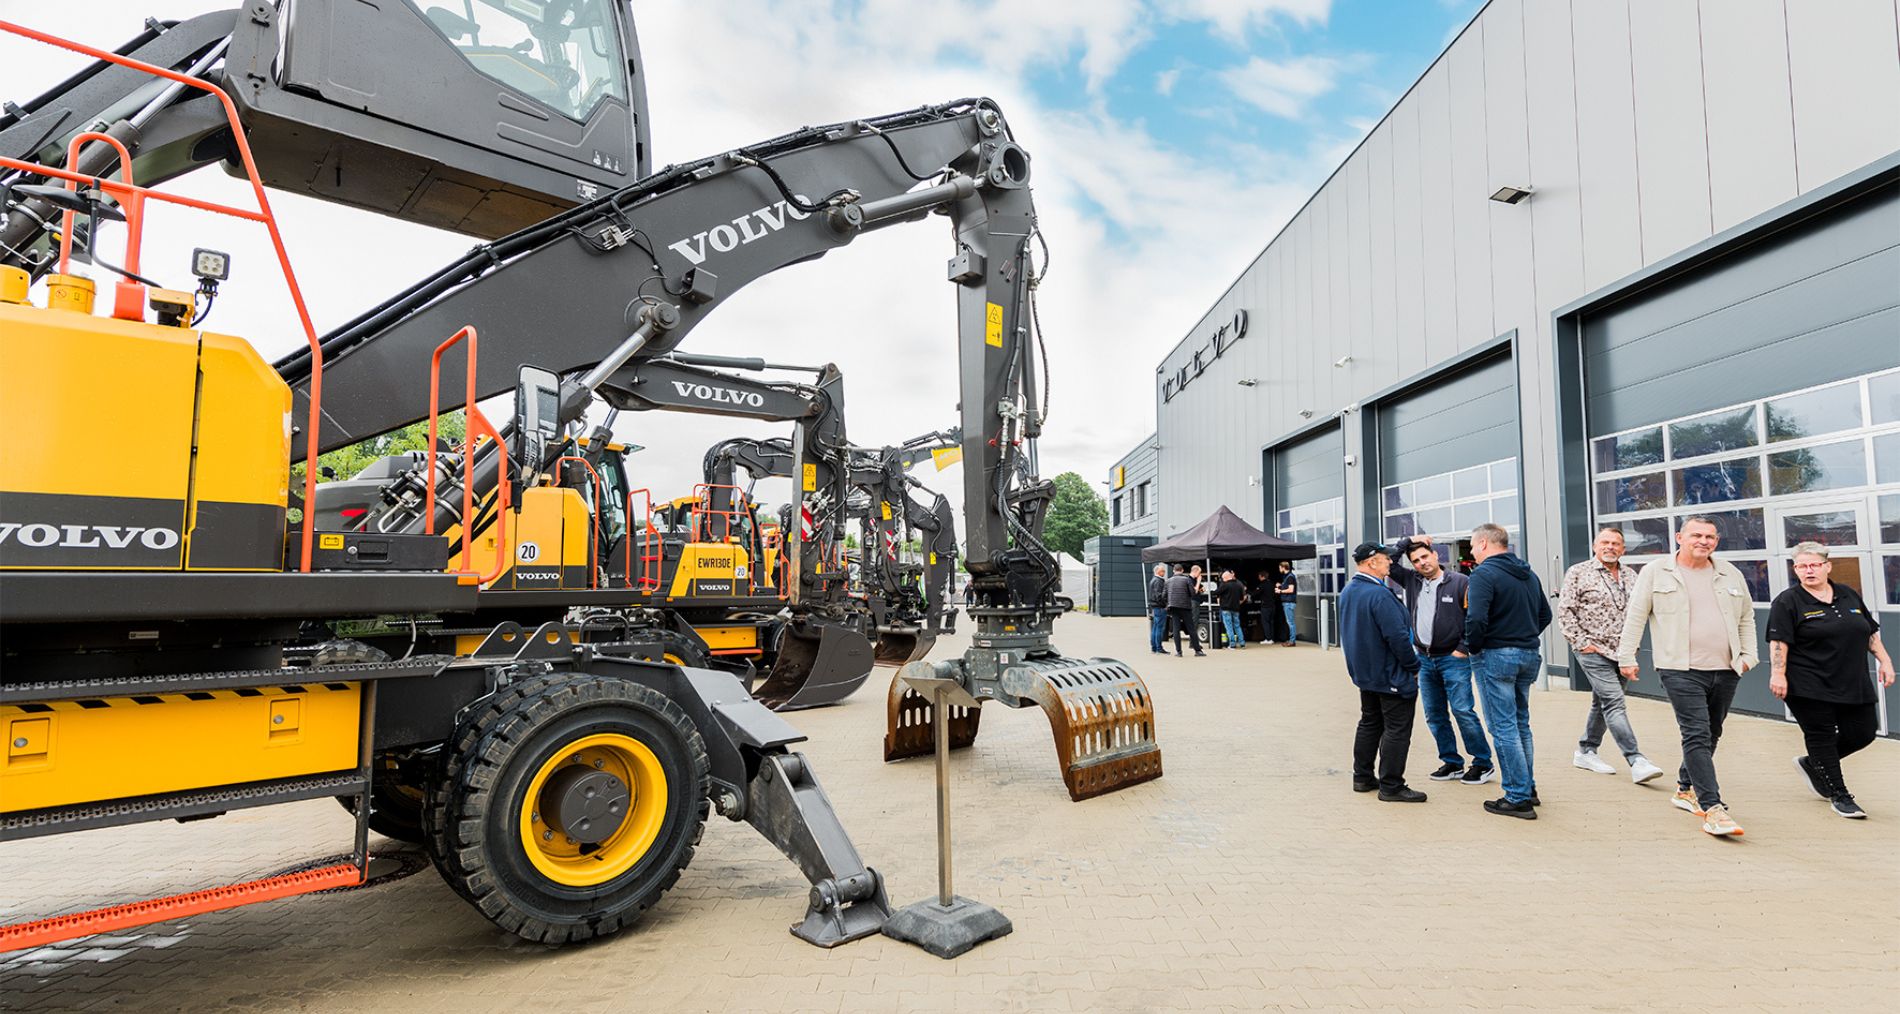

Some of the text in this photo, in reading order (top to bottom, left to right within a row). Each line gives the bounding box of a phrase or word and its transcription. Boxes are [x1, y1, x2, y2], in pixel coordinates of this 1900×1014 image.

[668, 194, 813, 265] VOLVO
[671, 381, 764, 407] VOLVO
[521, 545, 536, 560] 20
[697, 558, 731, 569] EWR130E
[516, 572, 560, 580] VOLVO
[737, 567, 745, 577] 20
